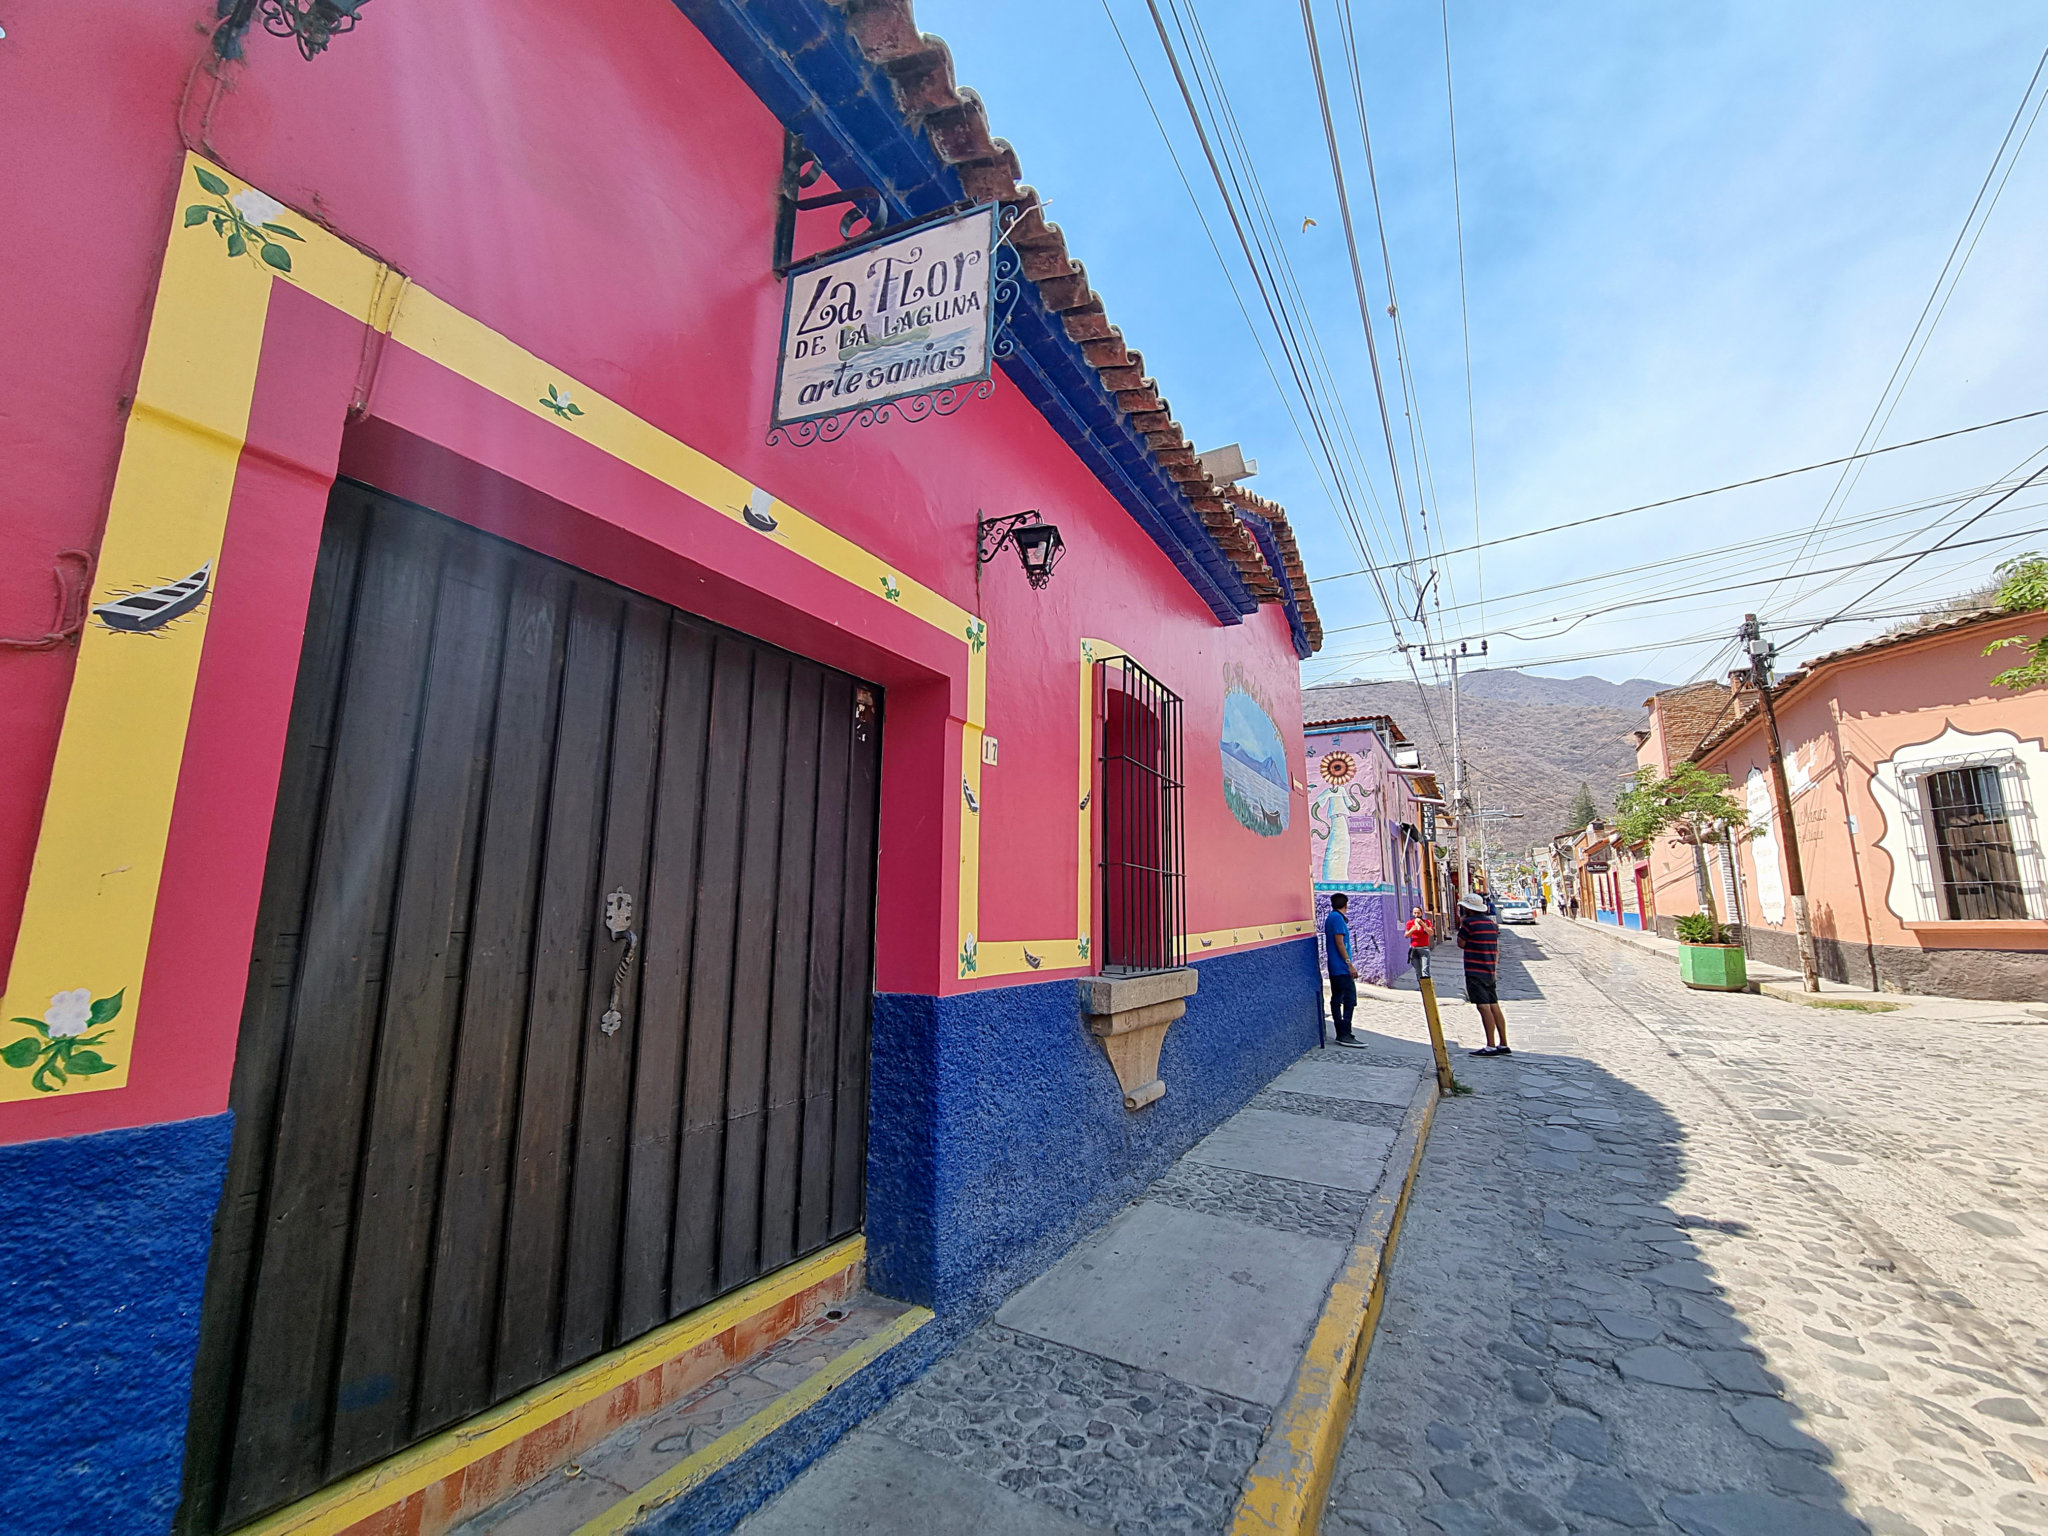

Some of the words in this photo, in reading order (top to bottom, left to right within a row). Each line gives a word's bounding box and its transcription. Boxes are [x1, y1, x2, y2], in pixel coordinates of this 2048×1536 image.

[794, 335, 827, 359] DE
[838, 323, 870, 350] LA
[883, 291, 981, 340] LAGUNA
[796, 275, 862, 336] La
[797, 343, 966, 405] artesanias
[985, 740, 997, 761] 17
